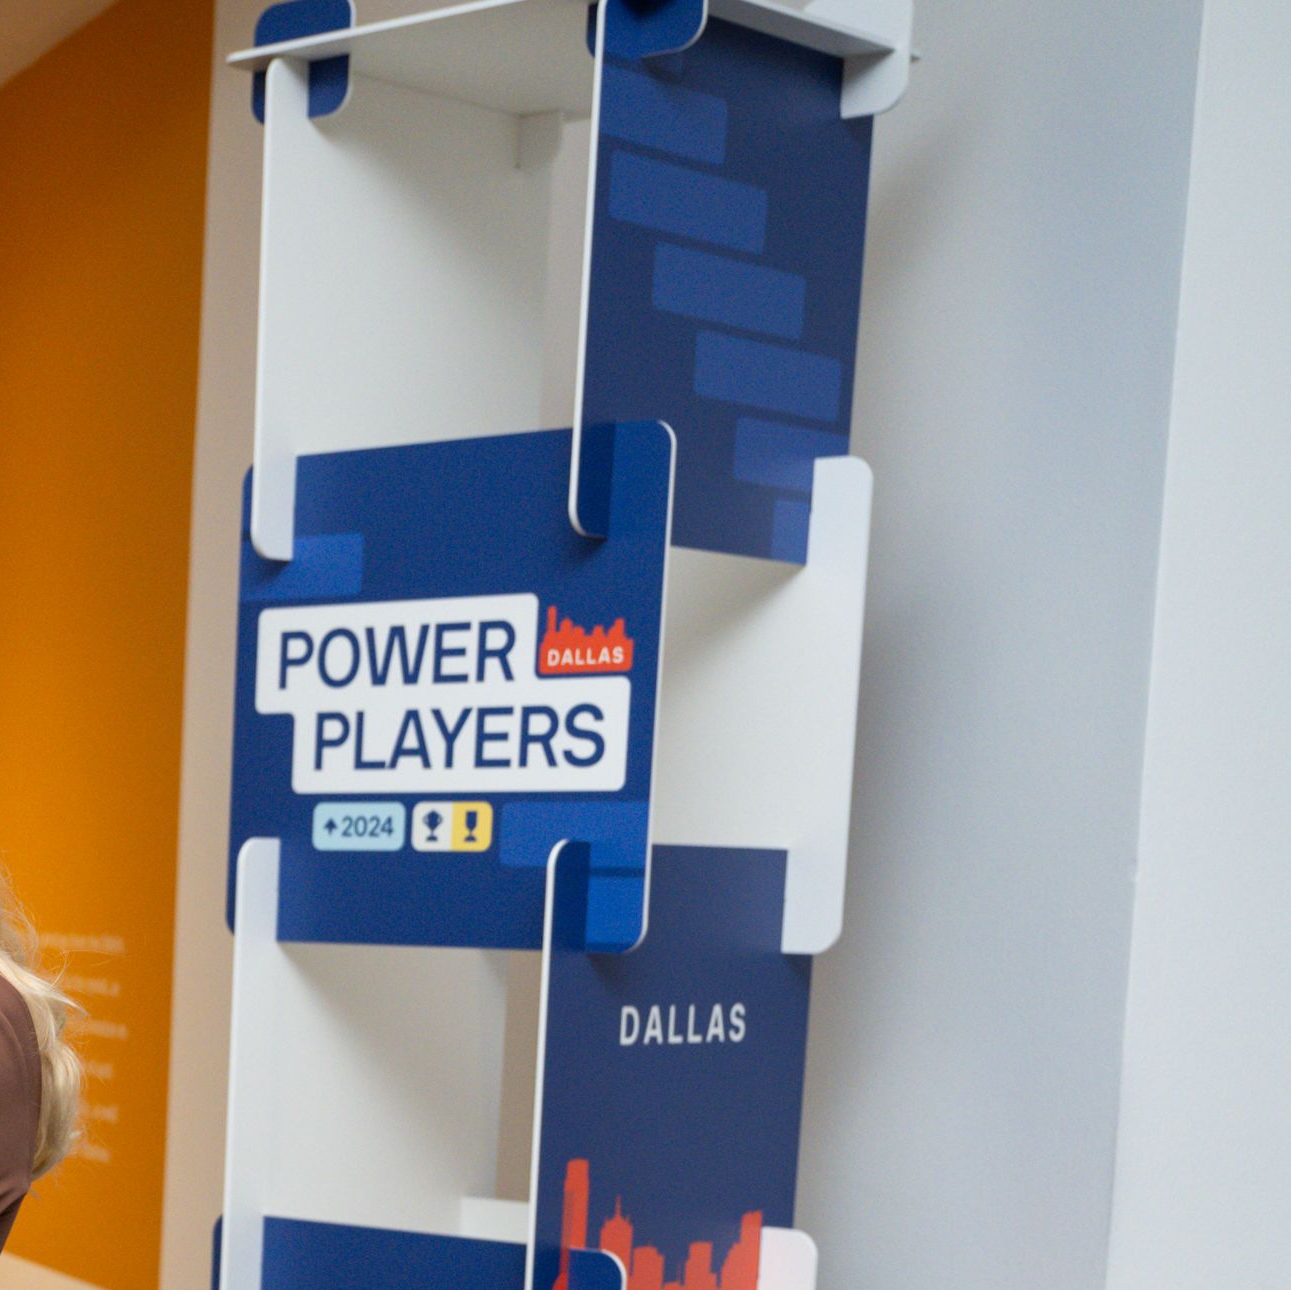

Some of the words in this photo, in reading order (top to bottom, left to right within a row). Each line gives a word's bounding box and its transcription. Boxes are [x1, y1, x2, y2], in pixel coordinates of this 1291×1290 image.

[279, 620, 516, 689] POWER
[547, 646, 624, 667] DALLAS
[314, 704, 605, 771] PLAYERS
[342, 816, 394, 838] 2024
[620, 1003, 746, 1046] DALLAS
